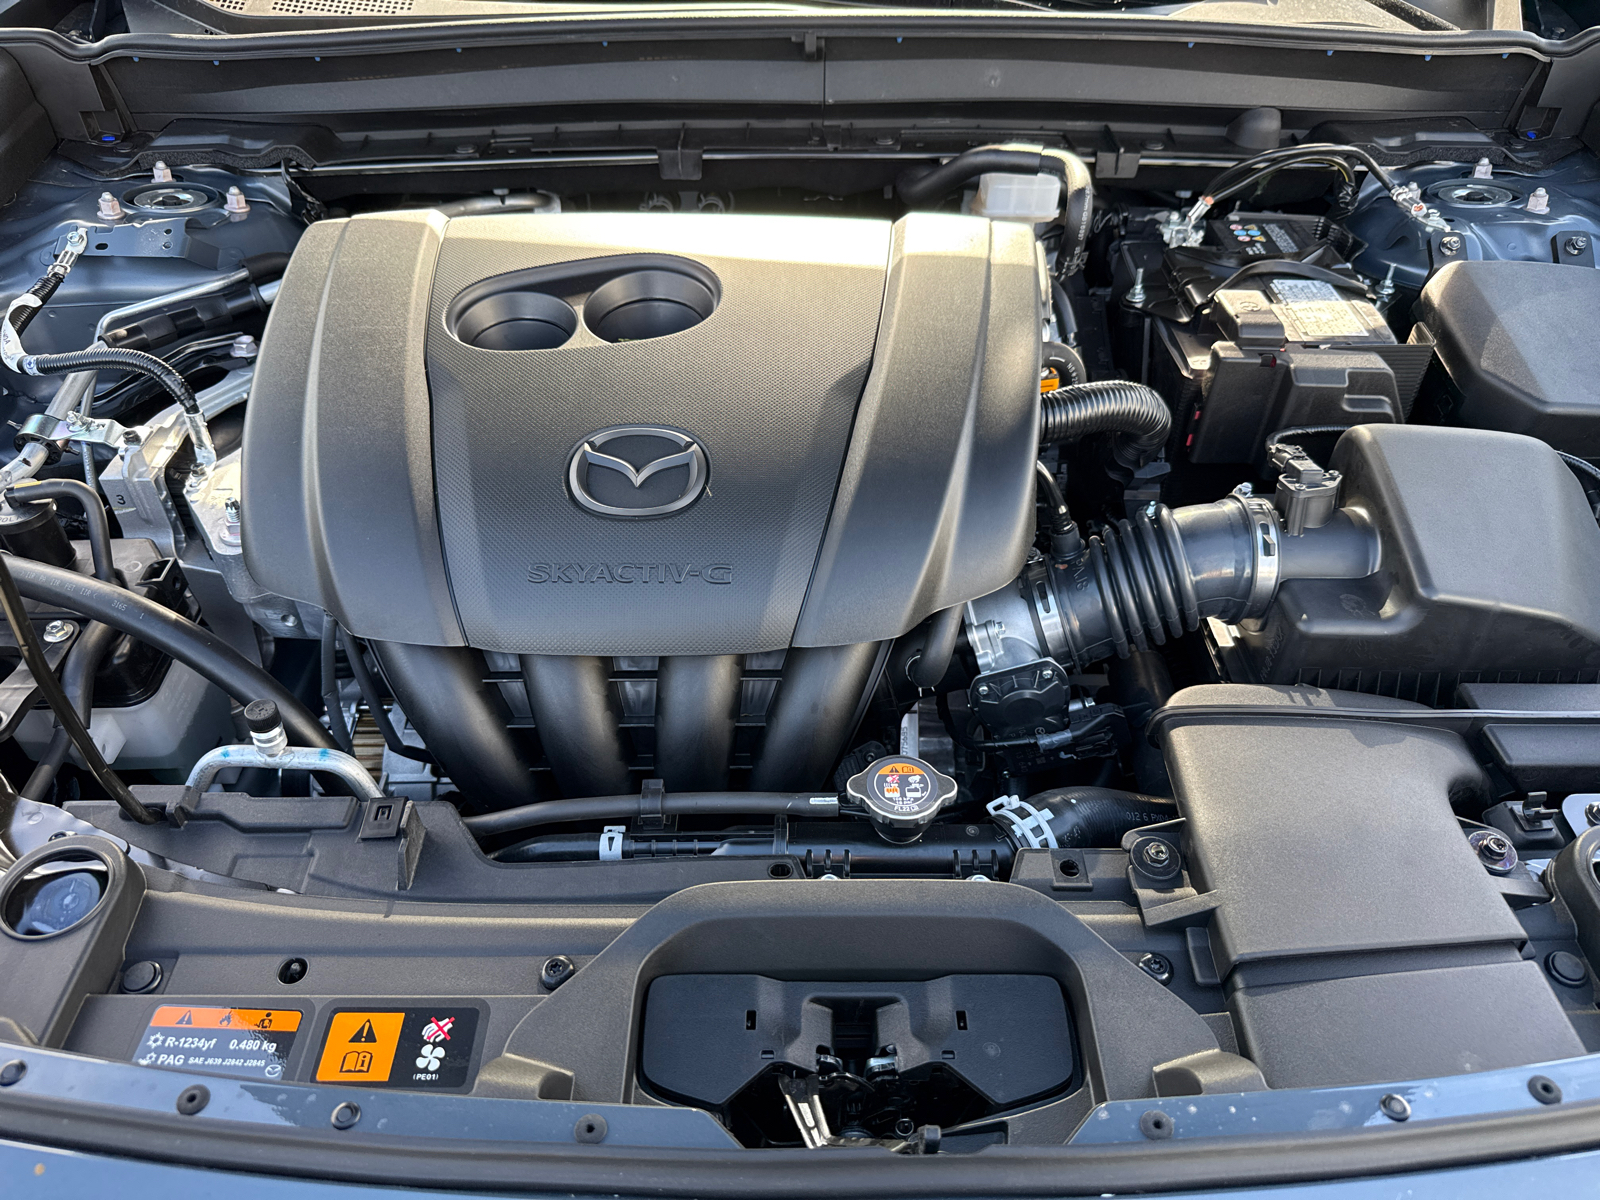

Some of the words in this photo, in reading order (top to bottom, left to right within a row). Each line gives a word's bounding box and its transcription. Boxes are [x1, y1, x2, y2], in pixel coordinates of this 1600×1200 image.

[116, 494, 126, 505] 3
[527, 562, 733, 585] SKYACTIV-G
[164, 1036, 217, 1051] R-1234yf
[229, 1038, 261, 1051] 0.480
[261, 1040, 277, 1053] kg
[157, 1053, 185, 1066] PAG
[188, 1056, 205, 1065] SAE
[204, 1057, 222, 1066] J639
